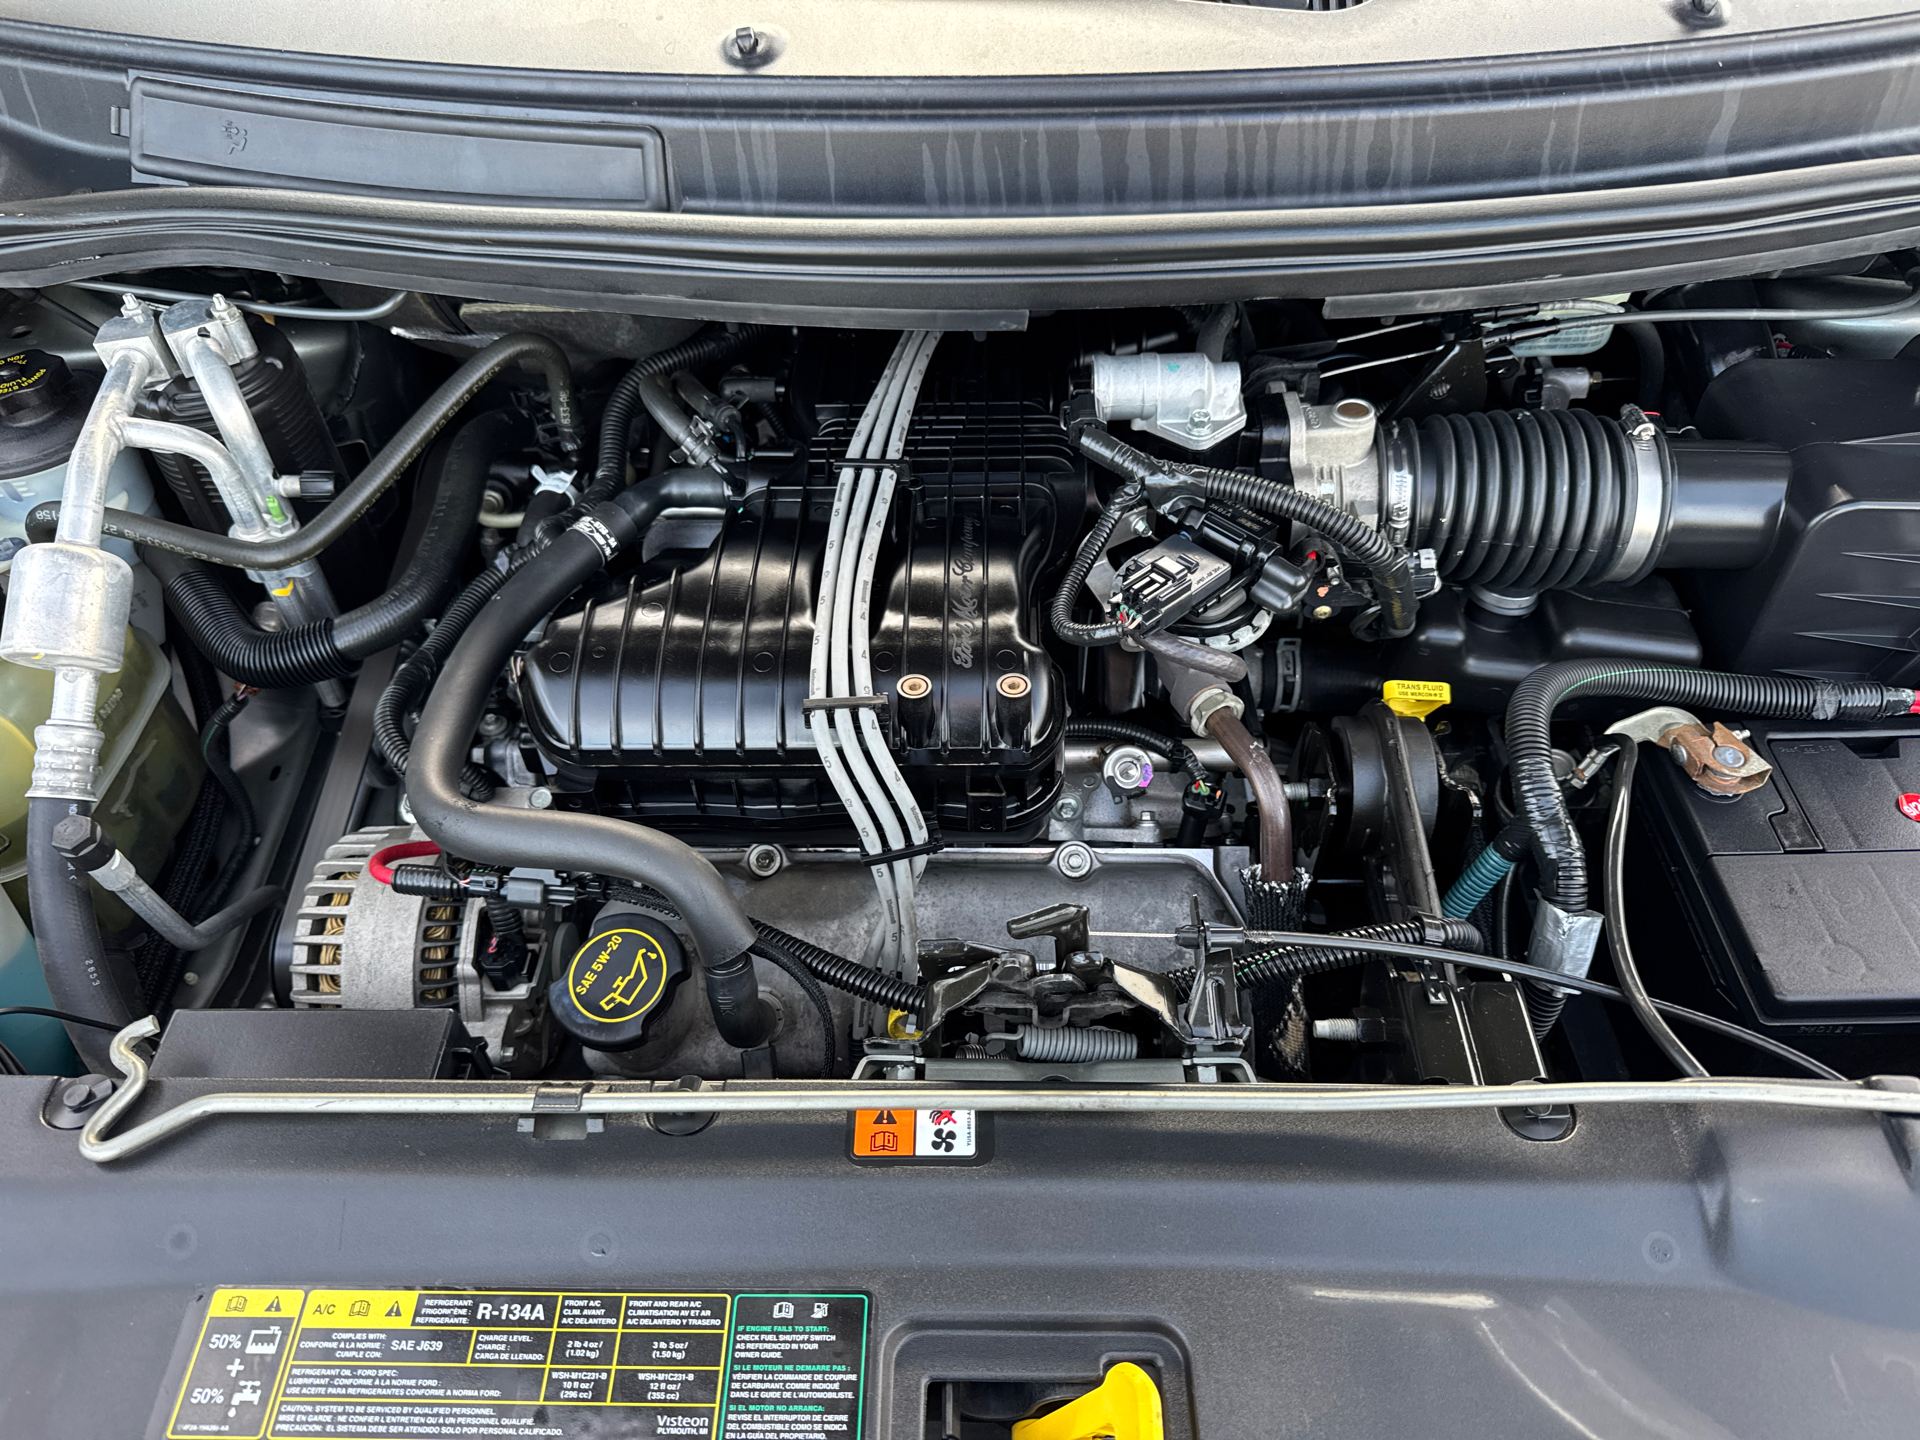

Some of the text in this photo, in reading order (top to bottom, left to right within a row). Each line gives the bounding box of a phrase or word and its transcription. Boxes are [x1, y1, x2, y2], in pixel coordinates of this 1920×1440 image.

[951, 512, 980, 669] Ford Motor Company
[1903, 798, 1920, 817] 9/2
[576, 935, 623, 995] SAE 5W-20
[313, 1304, 335, 1315] A/C
[477, 1303, 544, 1320] R-134A
[209, 1334, 241, 1349] 50%
[391, 1340, 443, 1351] SAE J639
[190, 1388, 224, 1404] 50%
[657, 1415, 708, 1426] Visteon
